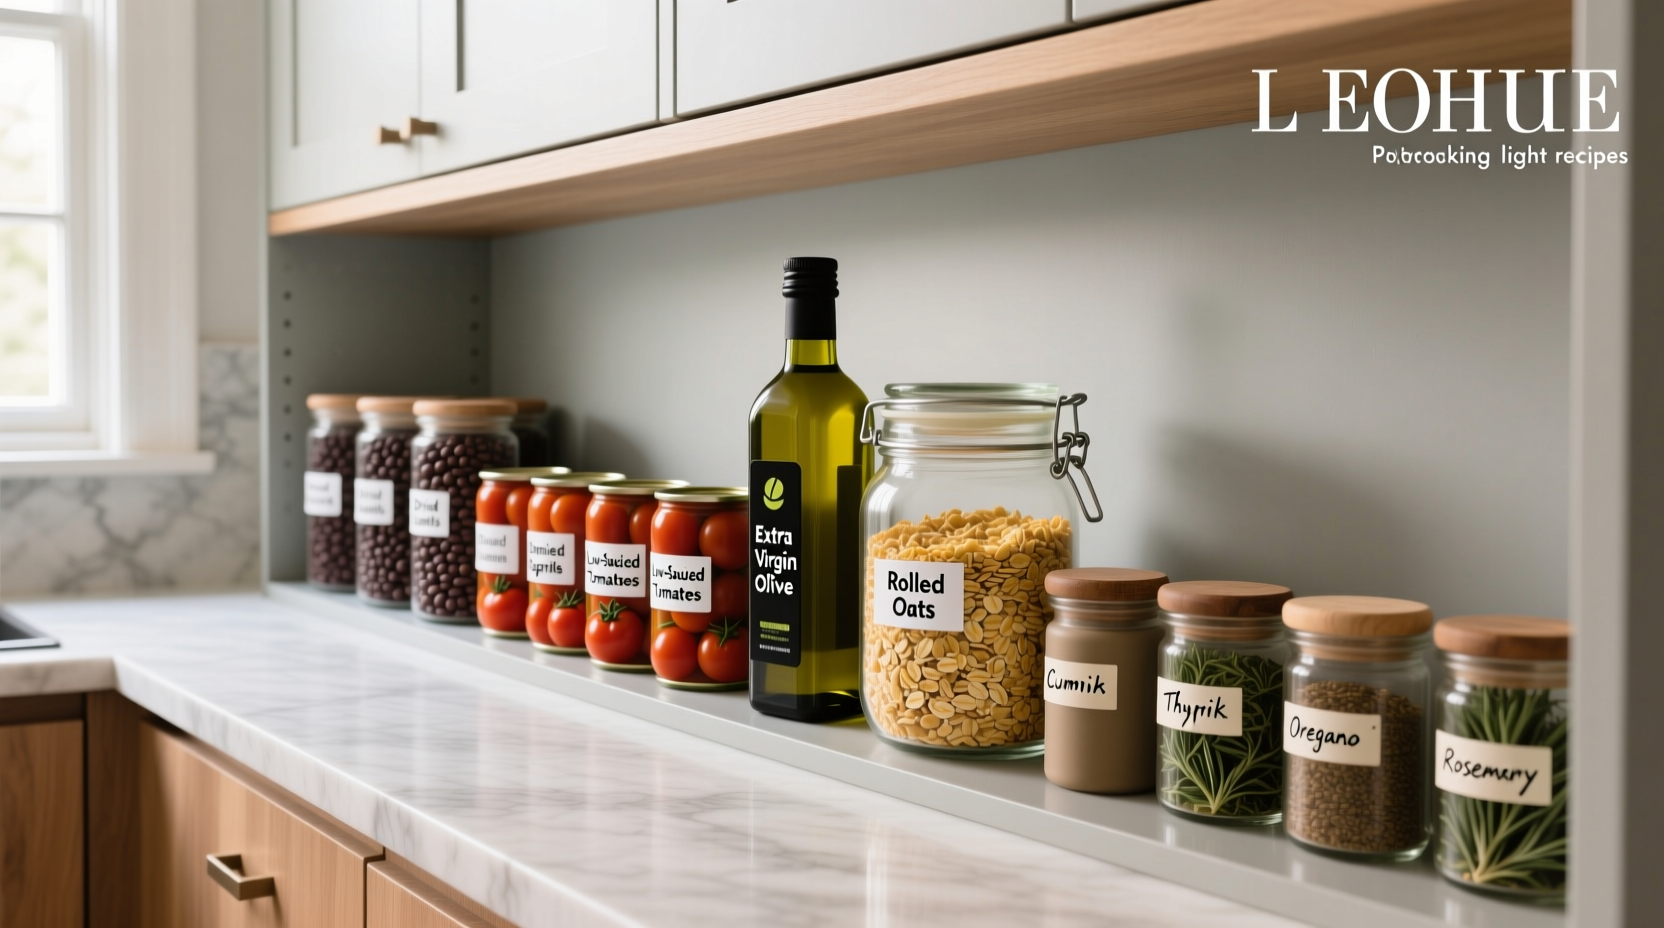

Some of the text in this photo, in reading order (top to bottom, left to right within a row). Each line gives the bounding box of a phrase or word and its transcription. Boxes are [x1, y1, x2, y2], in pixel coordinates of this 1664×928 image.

[755, 525, 793, 545] Extra
[755, 549, 797, 574] Virgin
[755, 574, 794, 595] Olive
[888, 570, 945, 594] Rolled
[892, 596, 935, 619] Oats
[1289, 716, 1360, 753] Oregano
